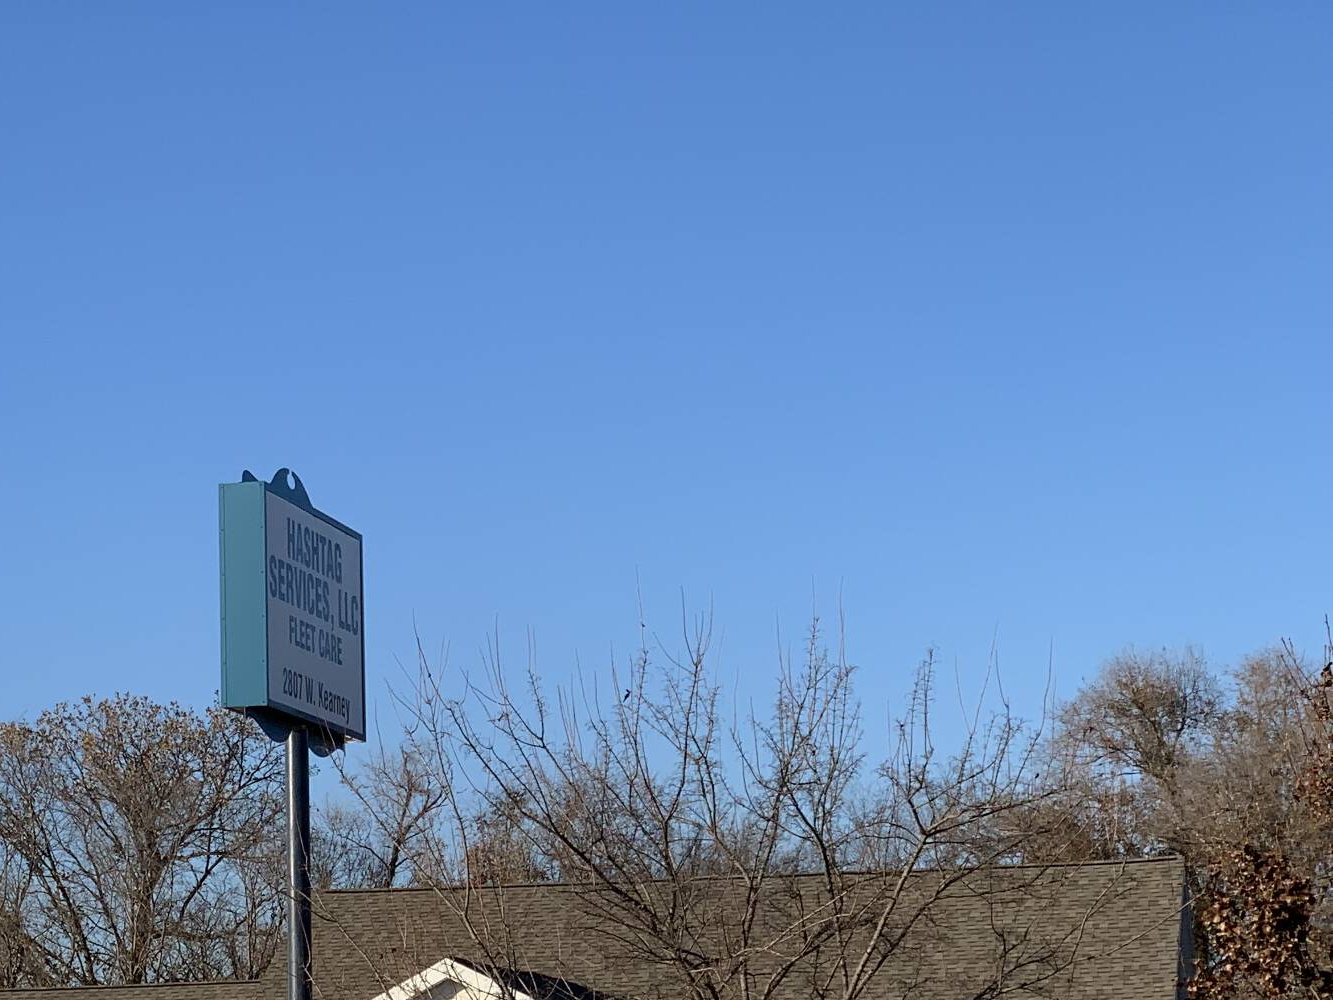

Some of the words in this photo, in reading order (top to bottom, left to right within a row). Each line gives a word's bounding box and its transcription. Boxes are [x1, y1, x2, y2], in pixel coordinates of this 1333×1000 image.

[287, 517, 342, 584] HASHTAG
[269, 555, 334, 631] SERVICES,
[338, 589, 358, 636] LLC
[289, 615, 316, 653] FLEET
[318, 628, 343, 666] CARE
[282, 667, 303, 700] 2807
[304, 675, 316, 706] W.
[318, 681, 351, 725] Kearney
